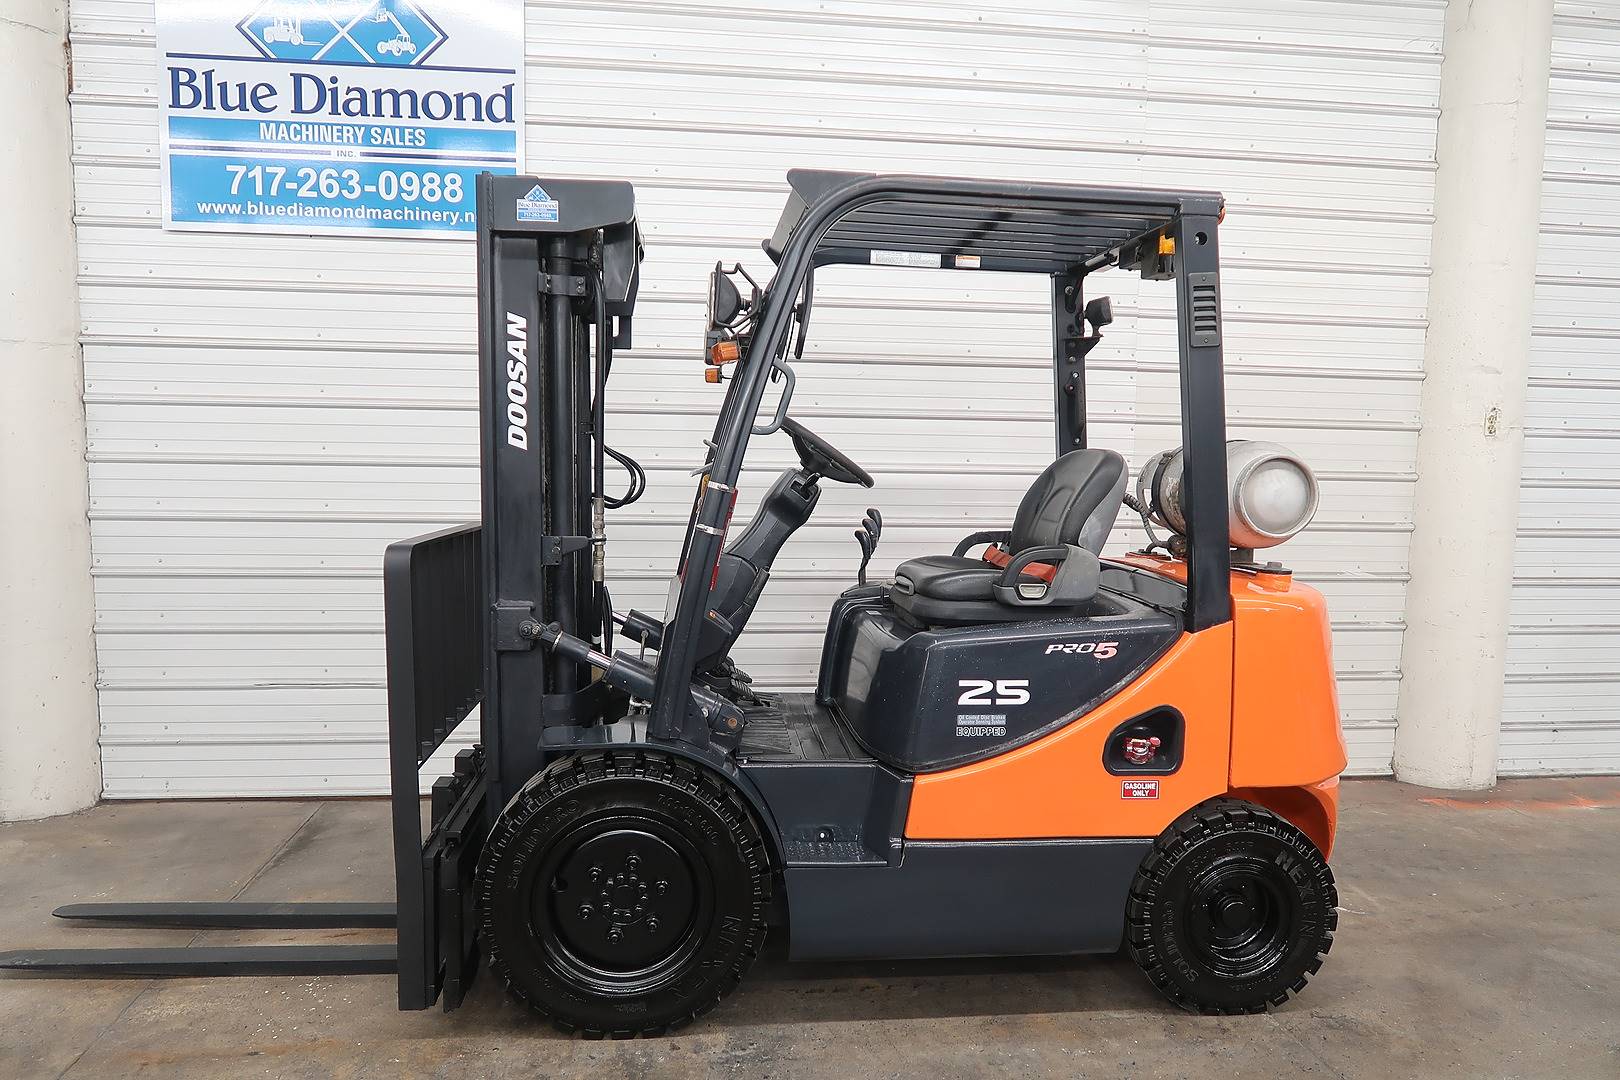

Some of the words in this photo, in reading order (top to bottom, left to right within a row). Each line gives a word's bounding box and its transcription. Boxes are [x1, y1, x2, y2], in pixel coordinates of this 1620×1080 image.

[166, 66, 279, 114] Blue
[289, 72, 516, 124] Diamond
[259, 121, 366, 146] MACHINERY
[370, 126, 427, 147] SALES
[336, 149, 357, 158] INC.
[225, 164, 464, 203] 717-263-0988
[196, 200, 476, 226] www.bluediamondmachinery.n
[506, 311, 528, 451] DOOSAN
[957, 679, 1031, 706] 25
[955, 726, 1007, 737] EQUIPPED
[1132, 789, 1149, 797] ONLY
